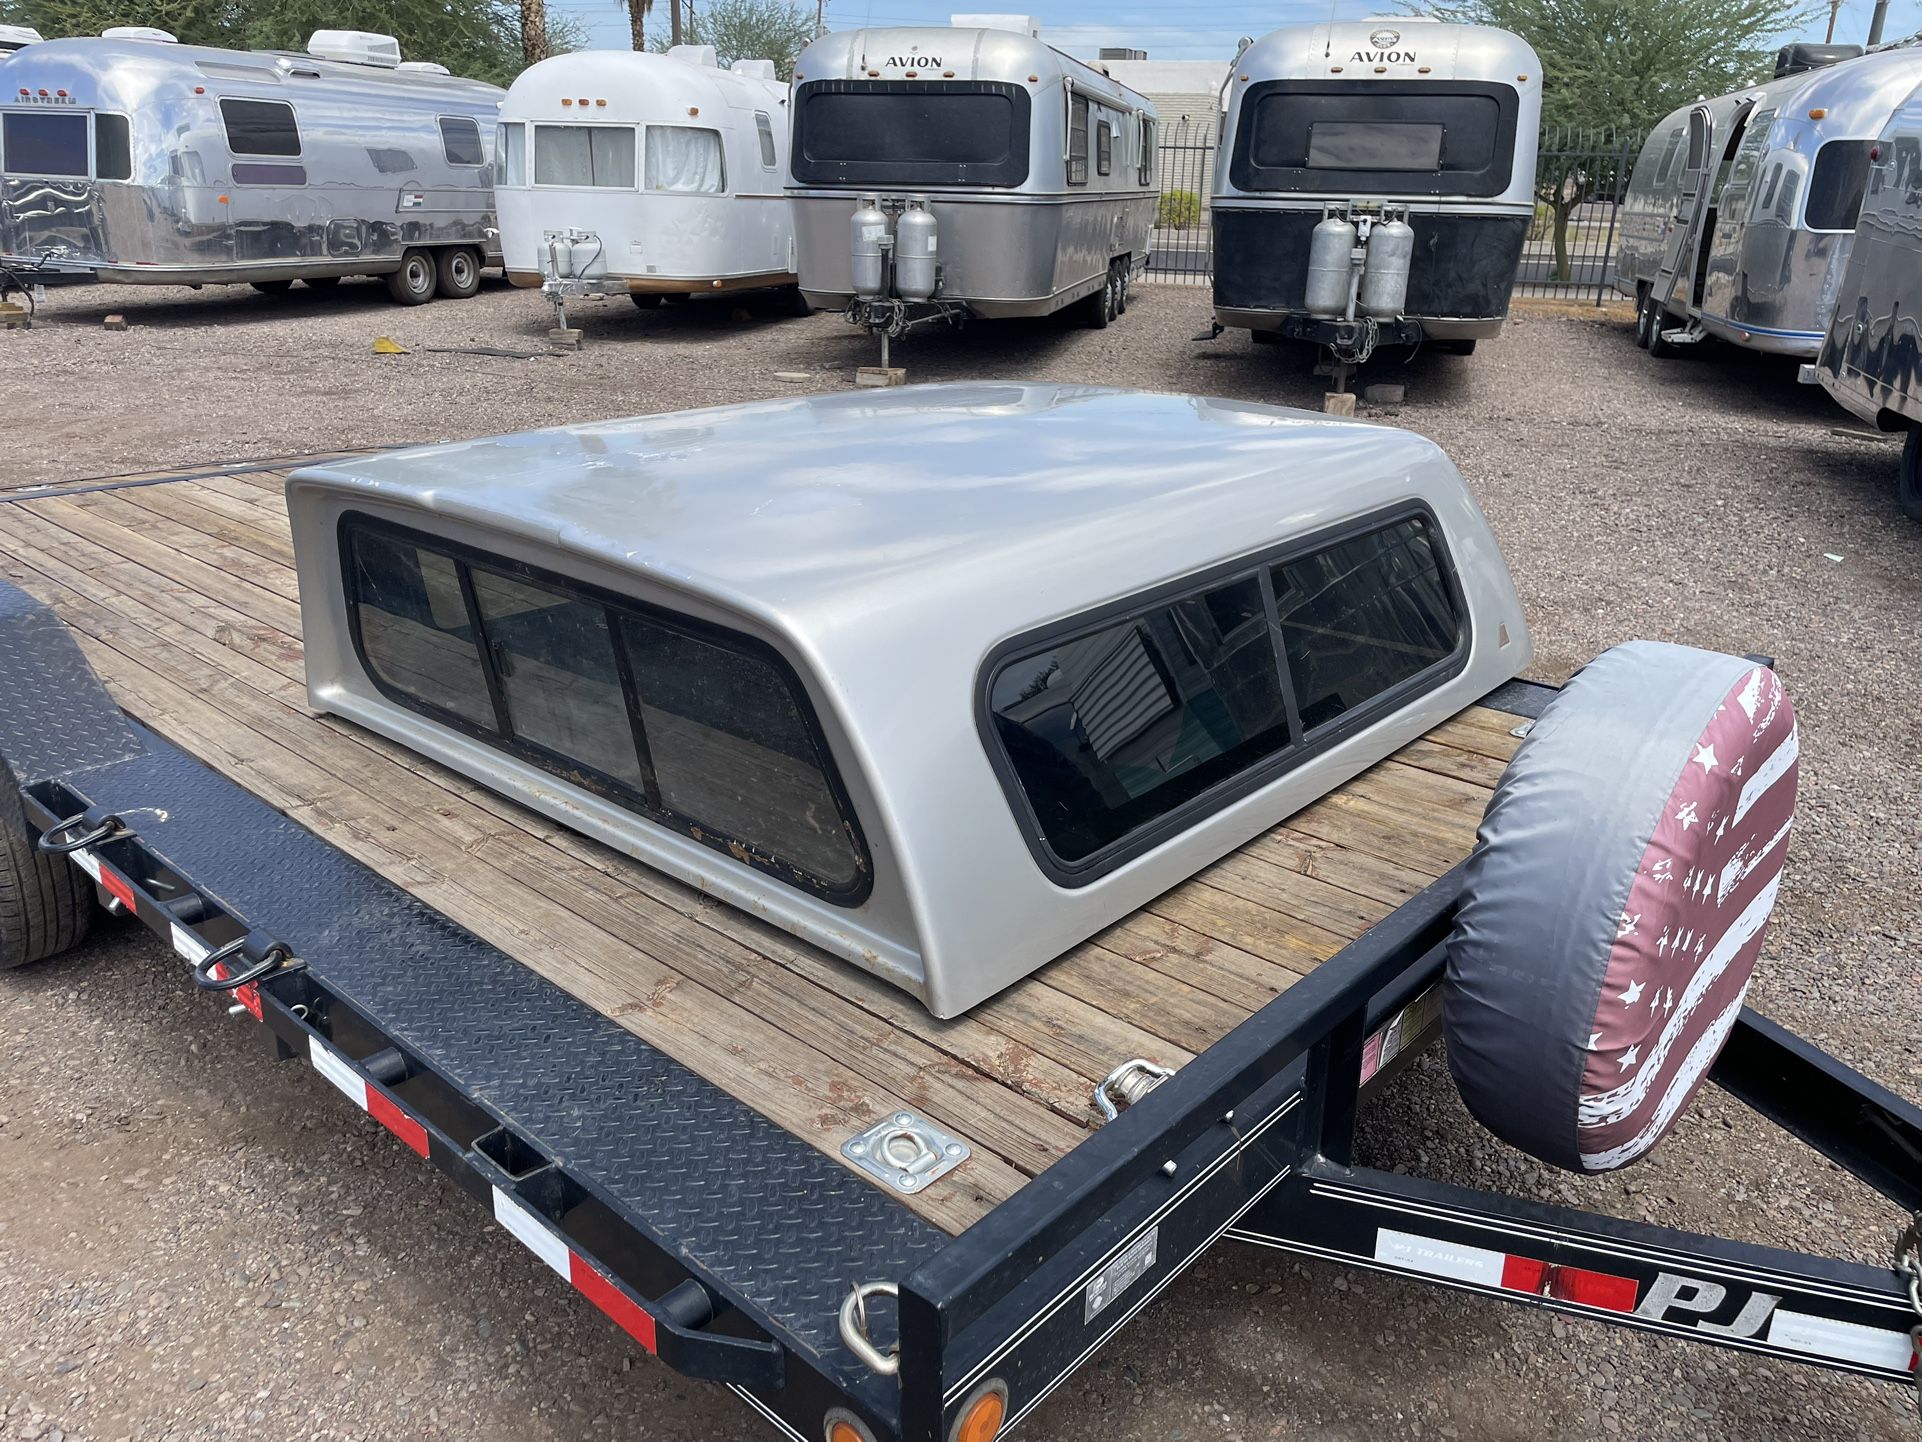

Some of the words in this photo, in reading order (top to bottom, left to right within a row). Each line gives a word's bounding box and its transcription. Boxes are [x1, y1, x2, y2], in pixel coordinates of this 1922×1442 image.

[885, 56, 943, 68] AVION
[1349, 51, 1417, 63] AVION
[14, 96, 77, 105] AIRSTREAM
[1633, 1271, 1784, 1338] PJ
